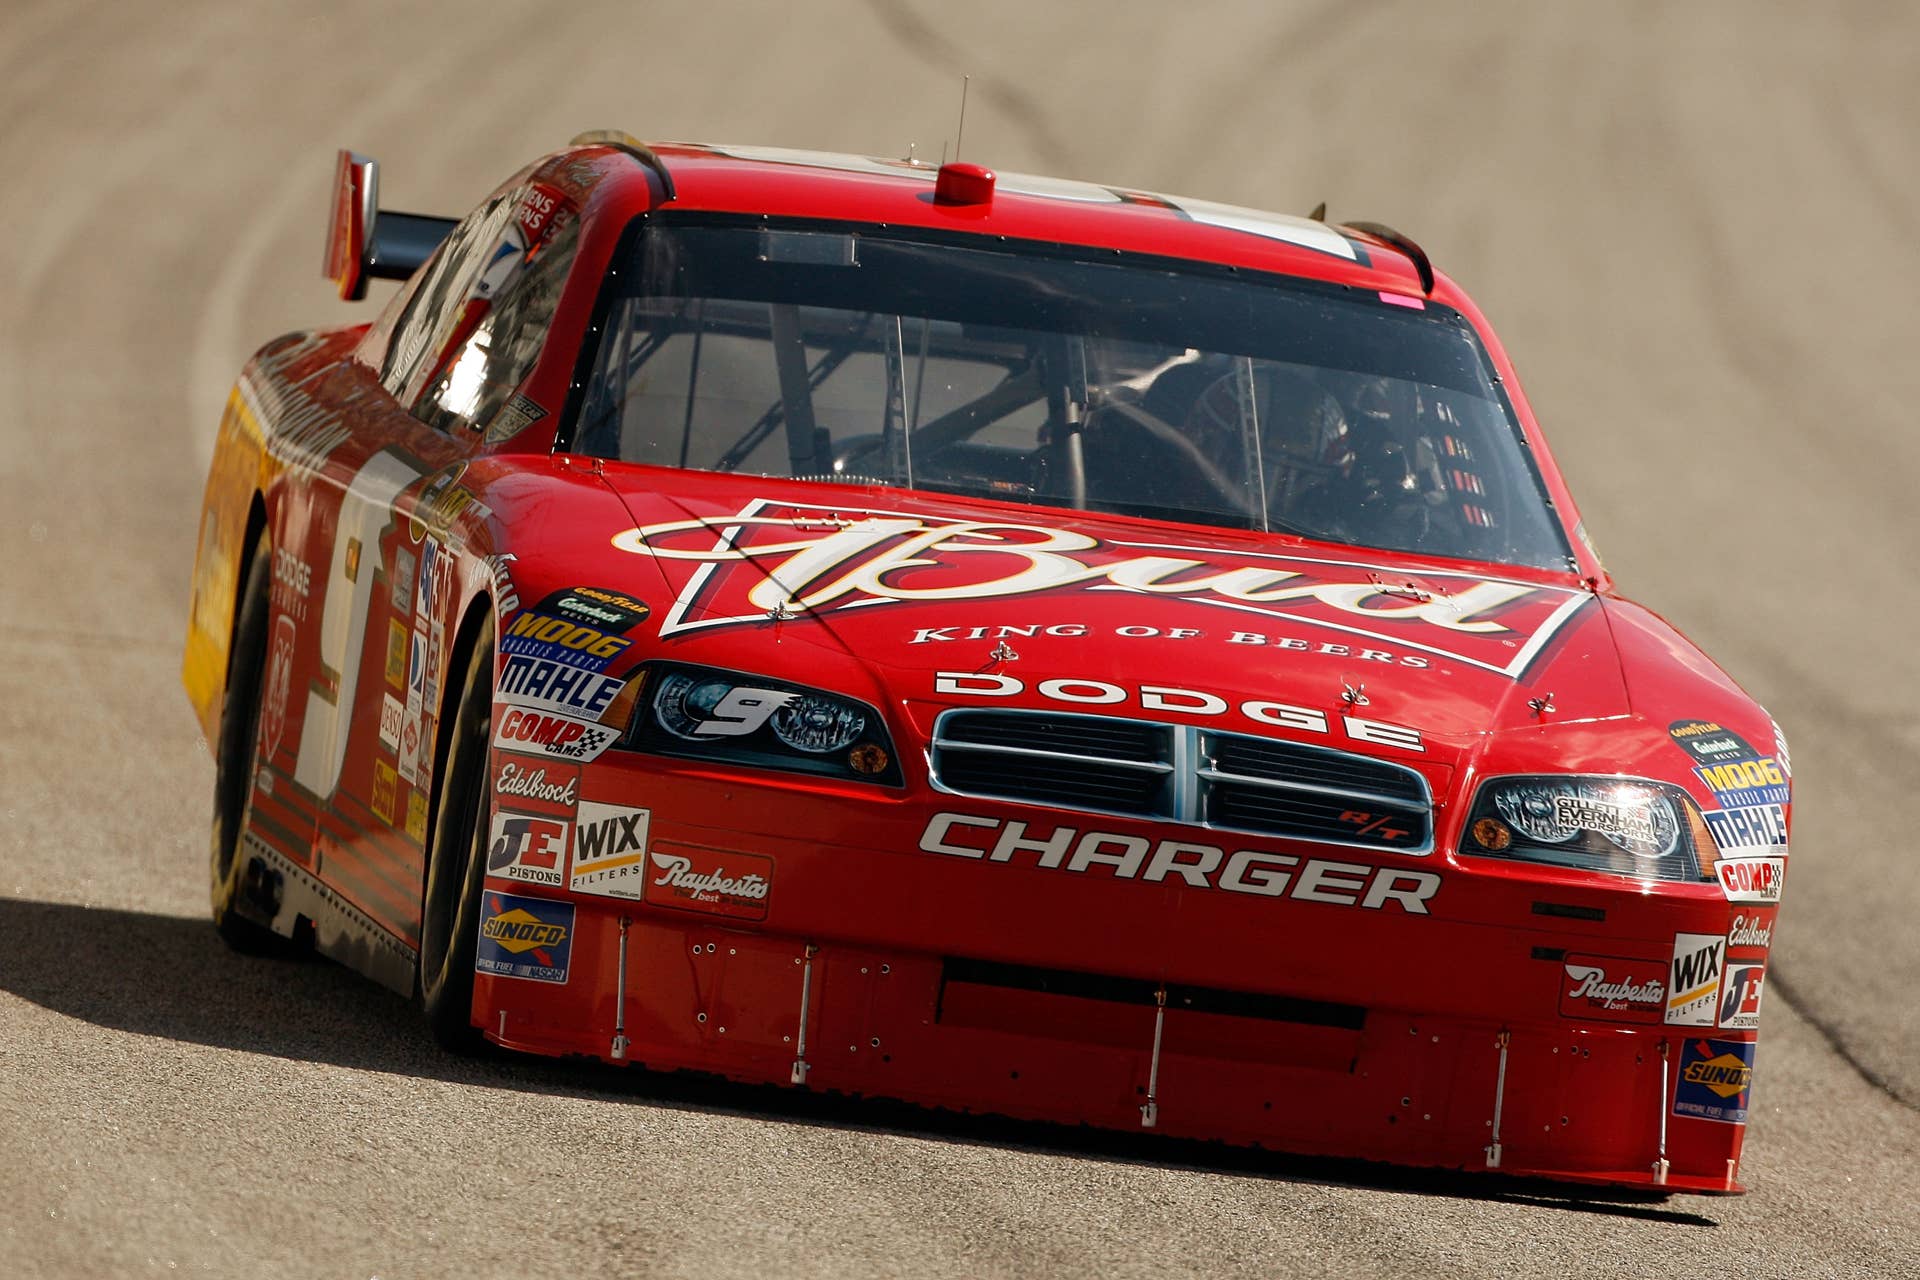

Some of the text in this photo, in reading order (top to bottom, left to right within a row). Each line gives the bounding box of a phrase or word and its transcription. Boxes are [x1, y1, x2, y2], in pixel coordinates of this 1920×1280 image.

[276, 548, 312, 597] DODGE
[611, 516, 1512, 633] Bud
[502, 638, 601, 671] CHASSIS PARTS
[505, 612, 632, 659] MOOG
[909, 623, 1430, 668] KING OF BEERS
[500, 658, 623, 713] MAHLE
[380, 702, 402, 740] DENSO
[501, 710, 585, 745] COMP
[695, 686, 802, 737] 9
[935, 670, 1426, 753] DODGE
[545, 742, 587, 758] CAMS
[496, 762, 577, 806] Edelbrock
[1700, 758, 1784, 792] MOOG
[577, 812, 642, 862] WIX
[1339, 809, 1410, 841] R/T
[1558, 817, 1654, 841] MOTORSPORTS
[1559, 807, 1652, 833] EVERNHAM
[1704, 806, 1787, 849] MAHLE
[487, 818, 562, 872] JE
[918, 812, 1443, 915] CHARGER
[509, 866, 562, 885] PISTONS
[572, 865, 640, 888] FILTERS
[651, 851, 769, 900] Raybestos
[1721, 862, 1773, 893] COMP
[699, 892, 719, 903] best
[483, 918, 567, 944] SUNOCO
[1728, 914, 1772, 949] Edelbrock
[1564, 964, 1665, 1009] Raybestos
[1674, 940, 1723, 994] WIX
[1610, 1002, 1628, 1011] best
[1667, 992, 1717, 1021] FILTERS
[1720, 966, 1764, 1025] JE
